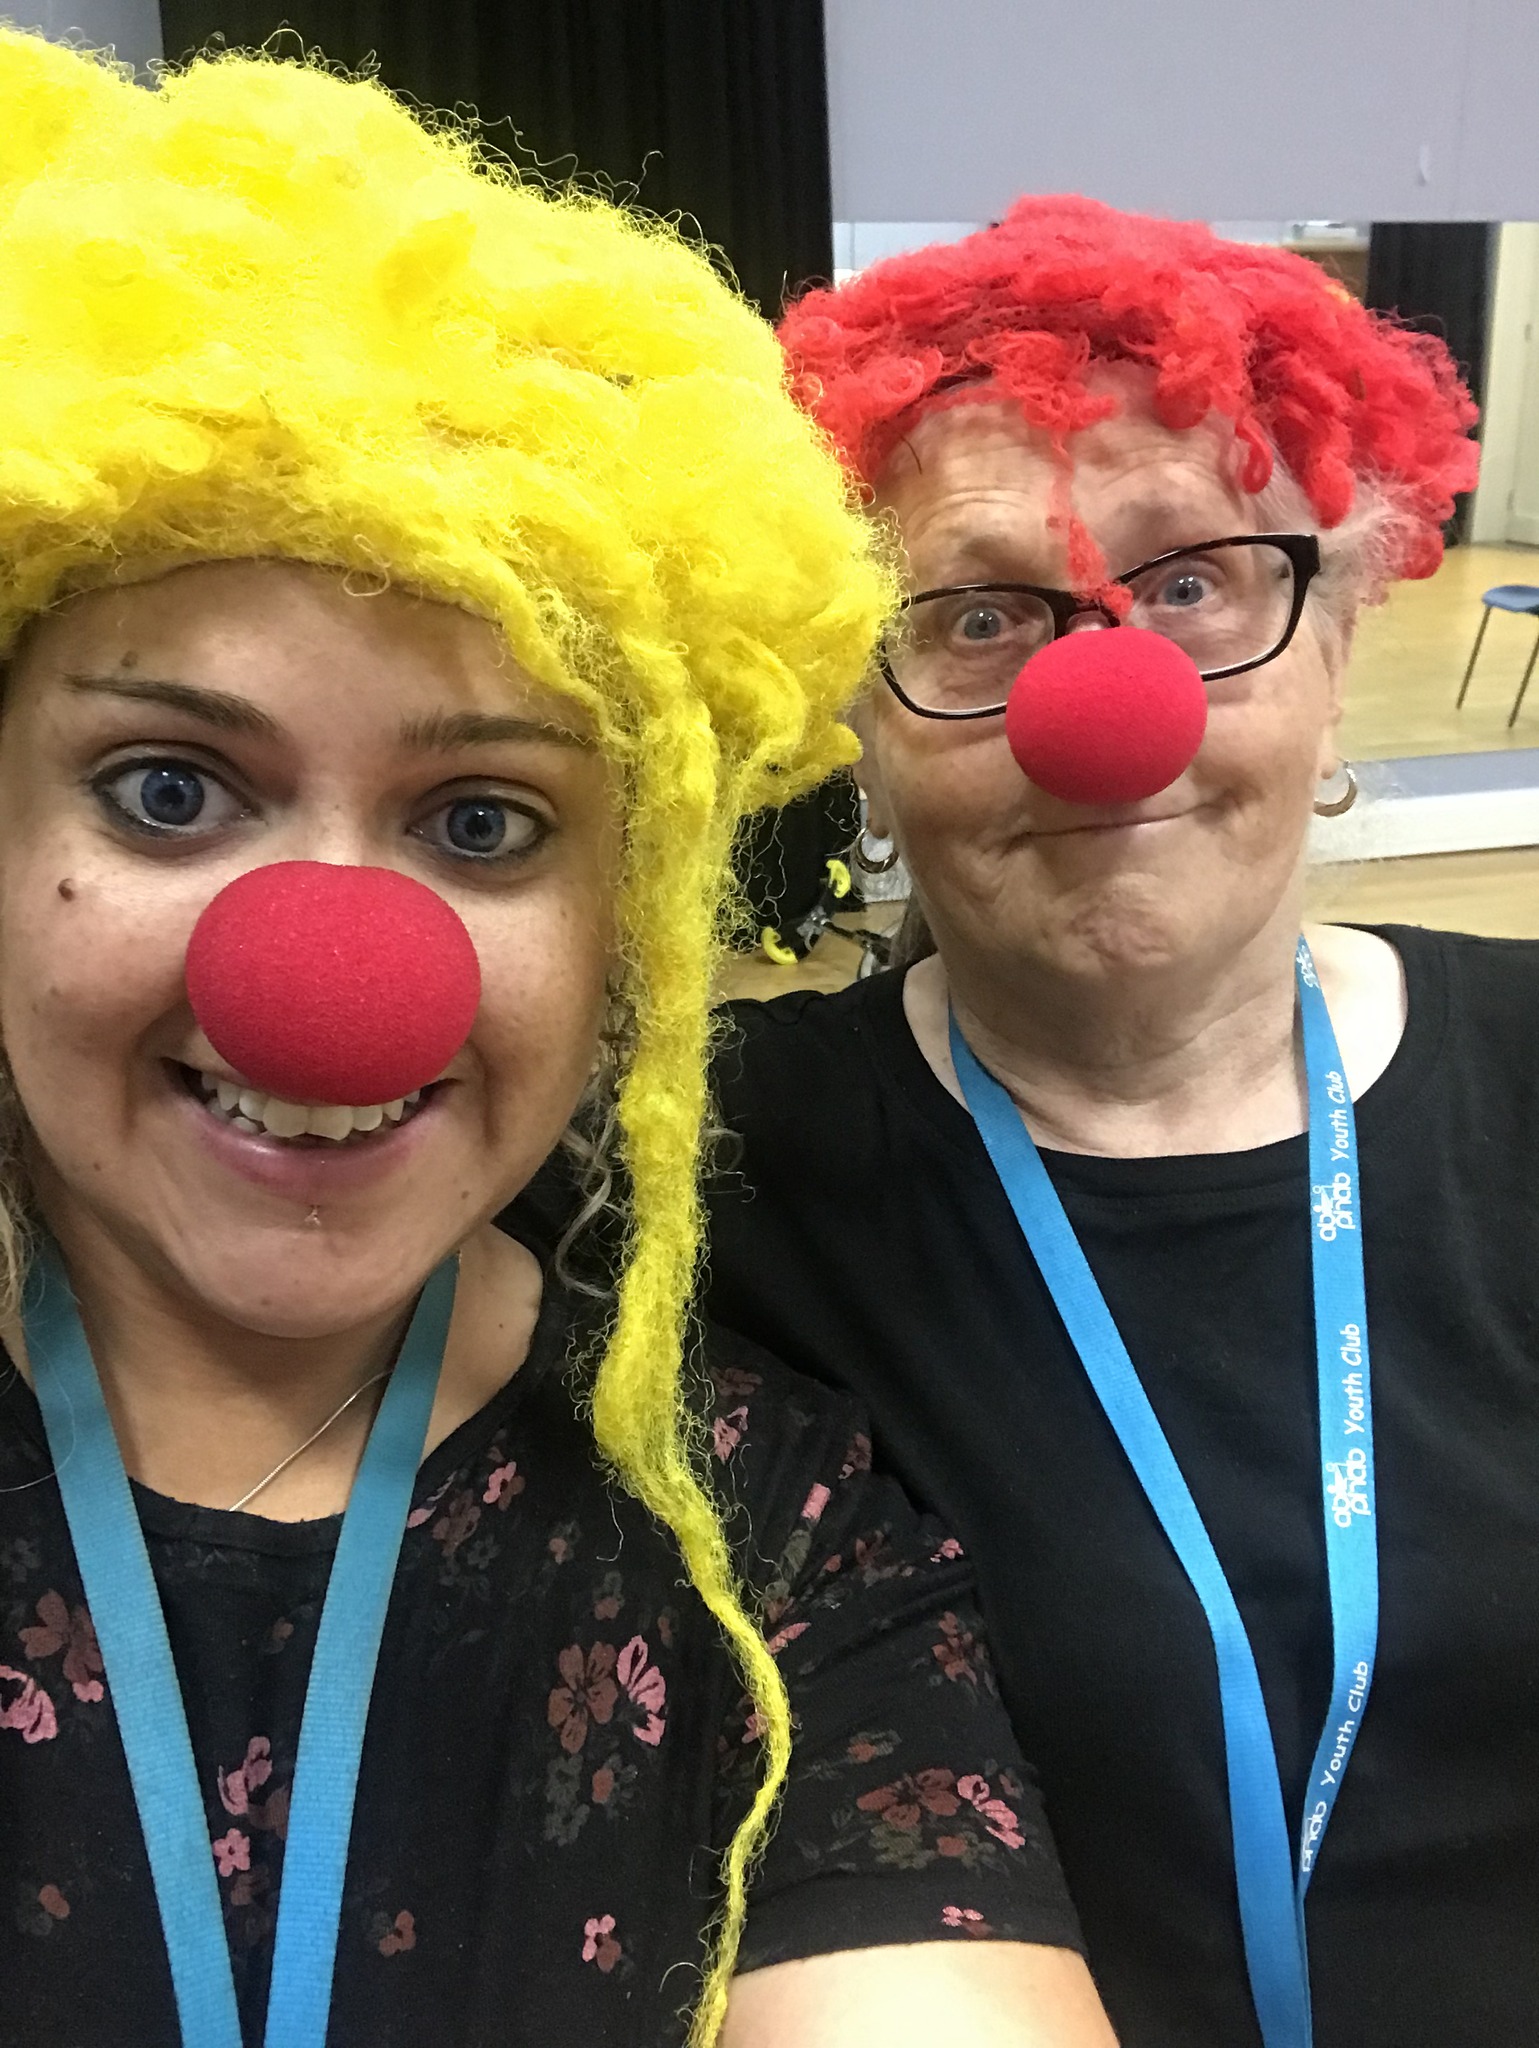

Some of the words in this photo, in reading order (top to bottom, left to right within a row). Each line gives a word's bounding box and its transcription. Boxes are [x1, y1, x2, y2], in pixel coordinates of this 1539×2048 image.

[1325, 1070, 1346, 1104] Club
[1328, 1109, 1350, 1162] Youth
[1340, 1323, 1362, 1367] Club
[1342, 1372, 1365, 1435] Youth
[1320, 1720, 1355, 1786] Youth
[1348, 1661, 1368, 1713] Club
